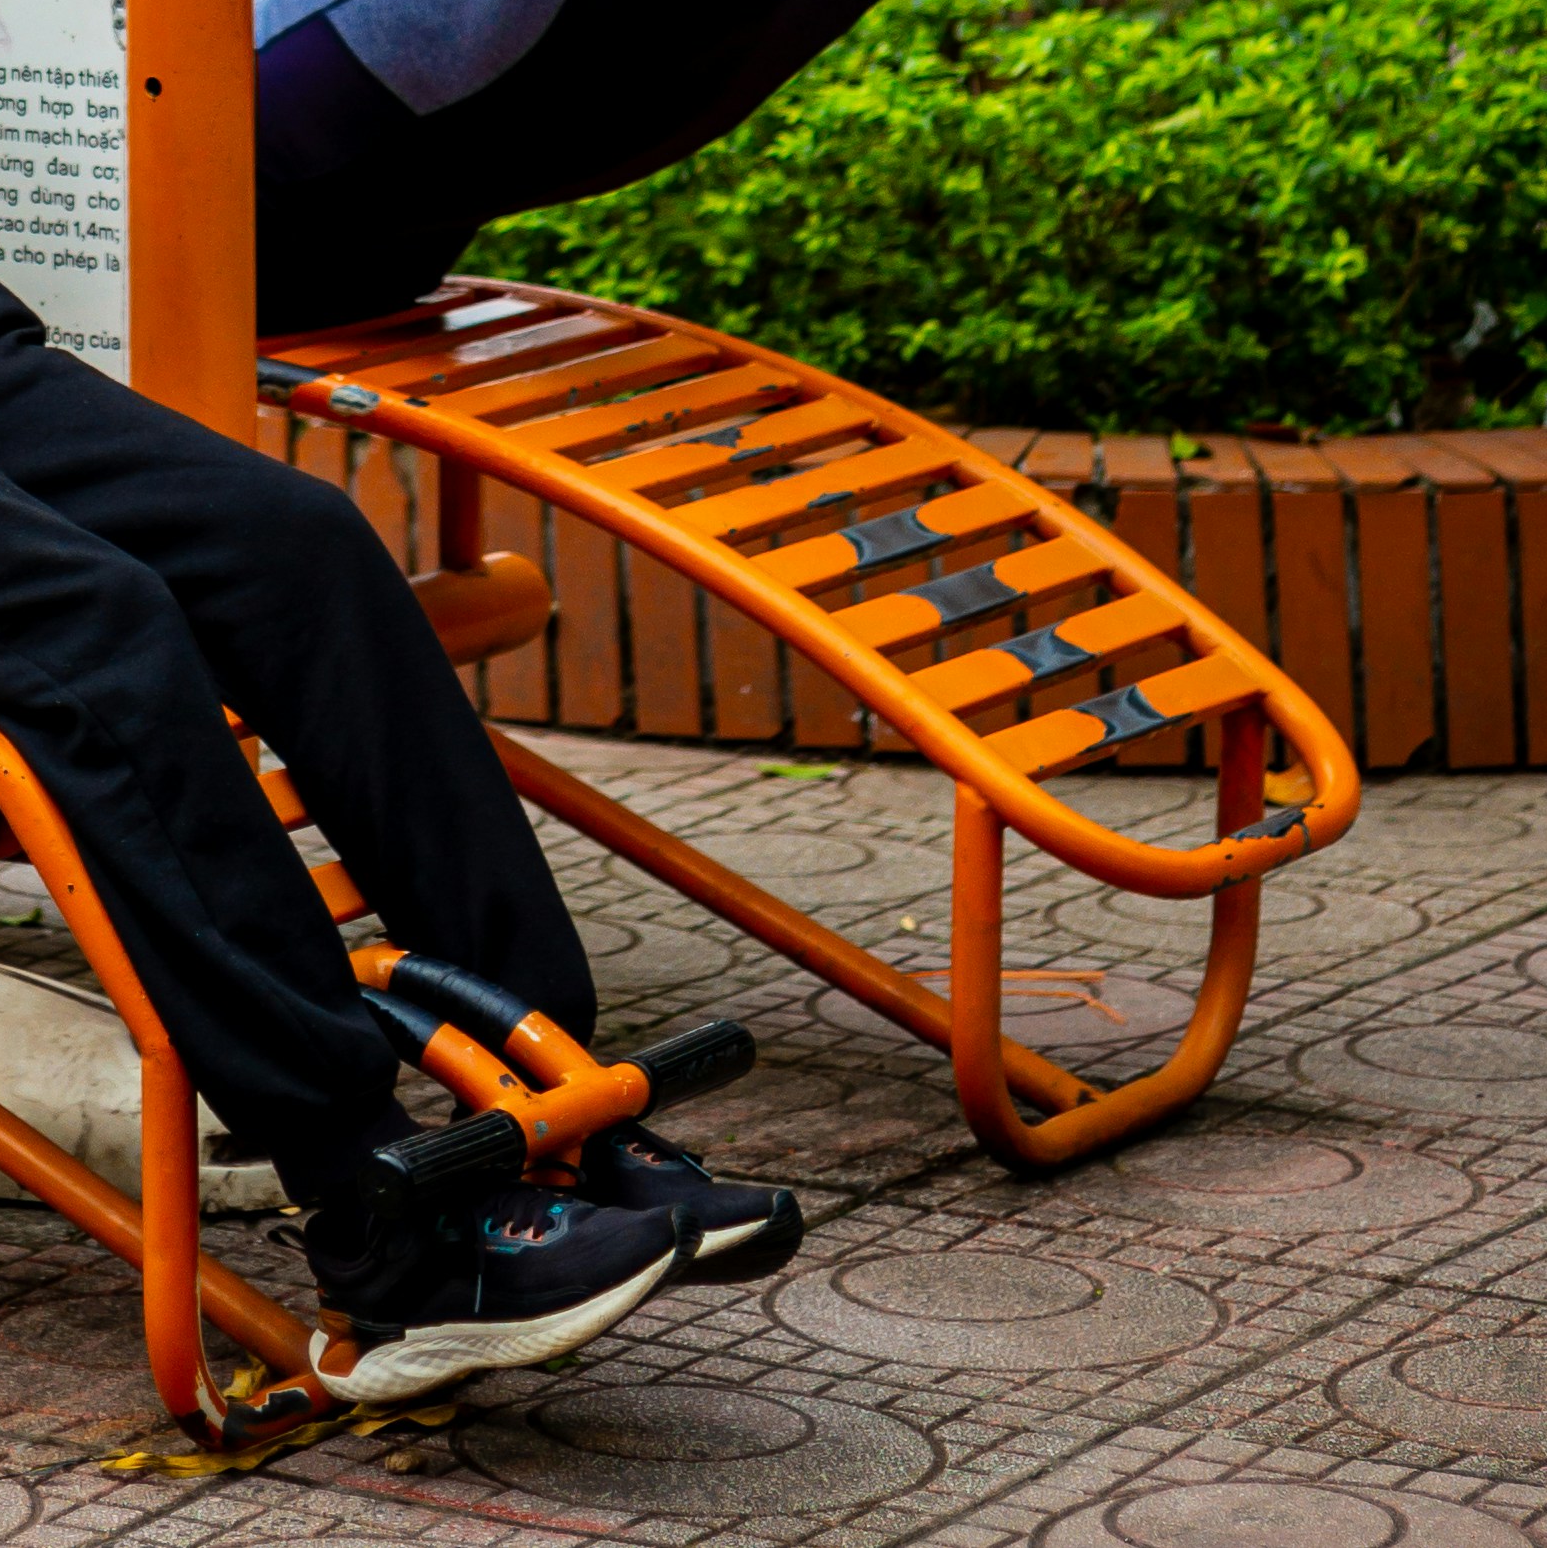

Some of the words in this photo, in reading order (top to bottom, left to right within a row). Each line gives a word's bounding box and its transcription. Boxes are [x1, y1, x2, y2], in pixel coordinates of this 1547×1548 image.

[11, 65, 42, 83] nên
[46, 67, 75, 89] tập
[78, 69, 119, 89] thiết
[40, 95, 74, 119] hợp
[87, 99, 119, 122] bạn
[25, 127, 72, 148] mạch
[76, 129, 119, 153] hoặc
[47, 156, 79, 177] đau
[92, 166, 119, 184] cơ;
[30, 186, 75, 211] dùng
[87, 191, 120, 211] cho
[29, 216, 68, 236] dưới
[73, 221, 120, 244] 1,4m;
[13, 245, 45, 265] cho
[53, 249, 98, 273] phép
[106, 253, 120, 272] là
[89, 331, 121, 350] của
